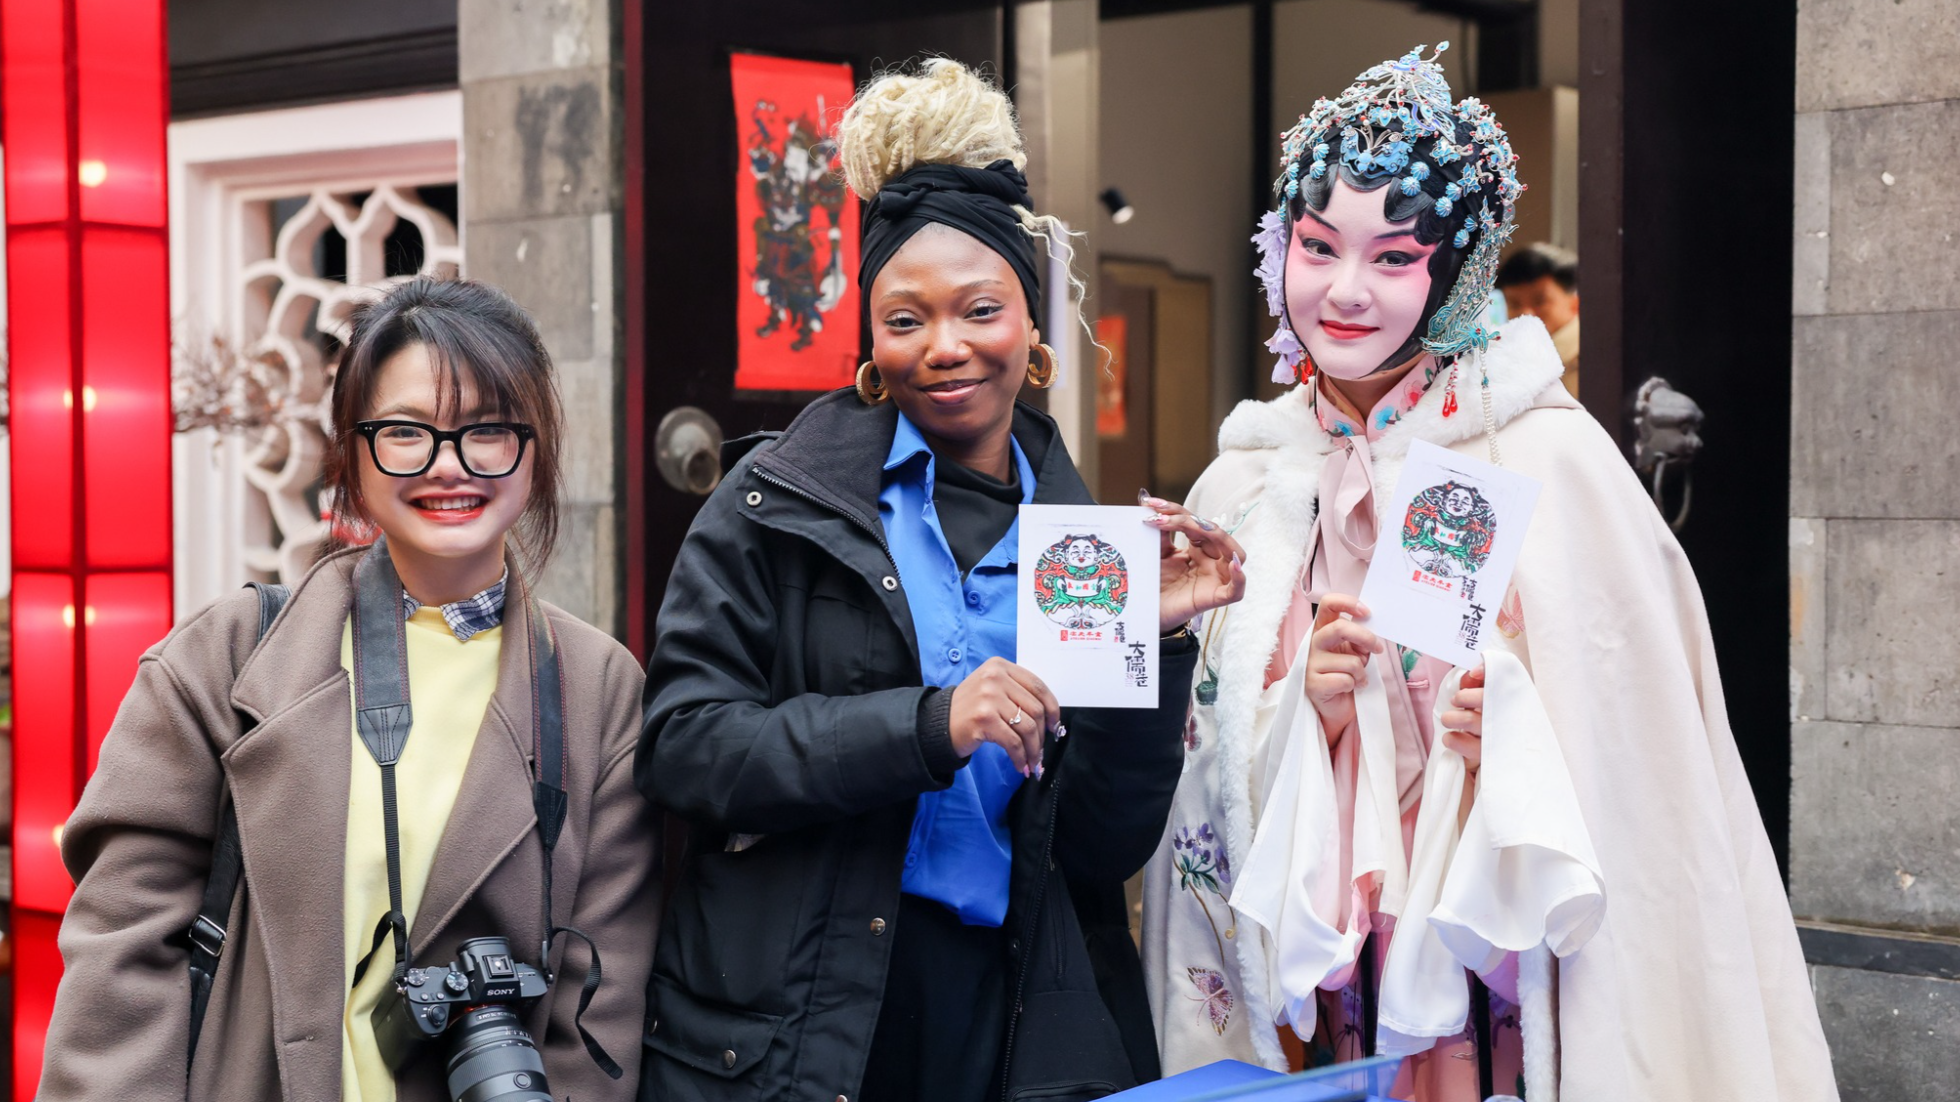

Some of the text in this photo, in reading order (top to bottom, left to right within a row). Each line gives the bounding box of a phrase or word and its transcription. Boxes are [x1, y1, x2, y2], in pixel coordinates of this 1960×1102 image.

[1124, 641, 1149, 687] 大儒巷
[487, 988, 515, 996] SONY
